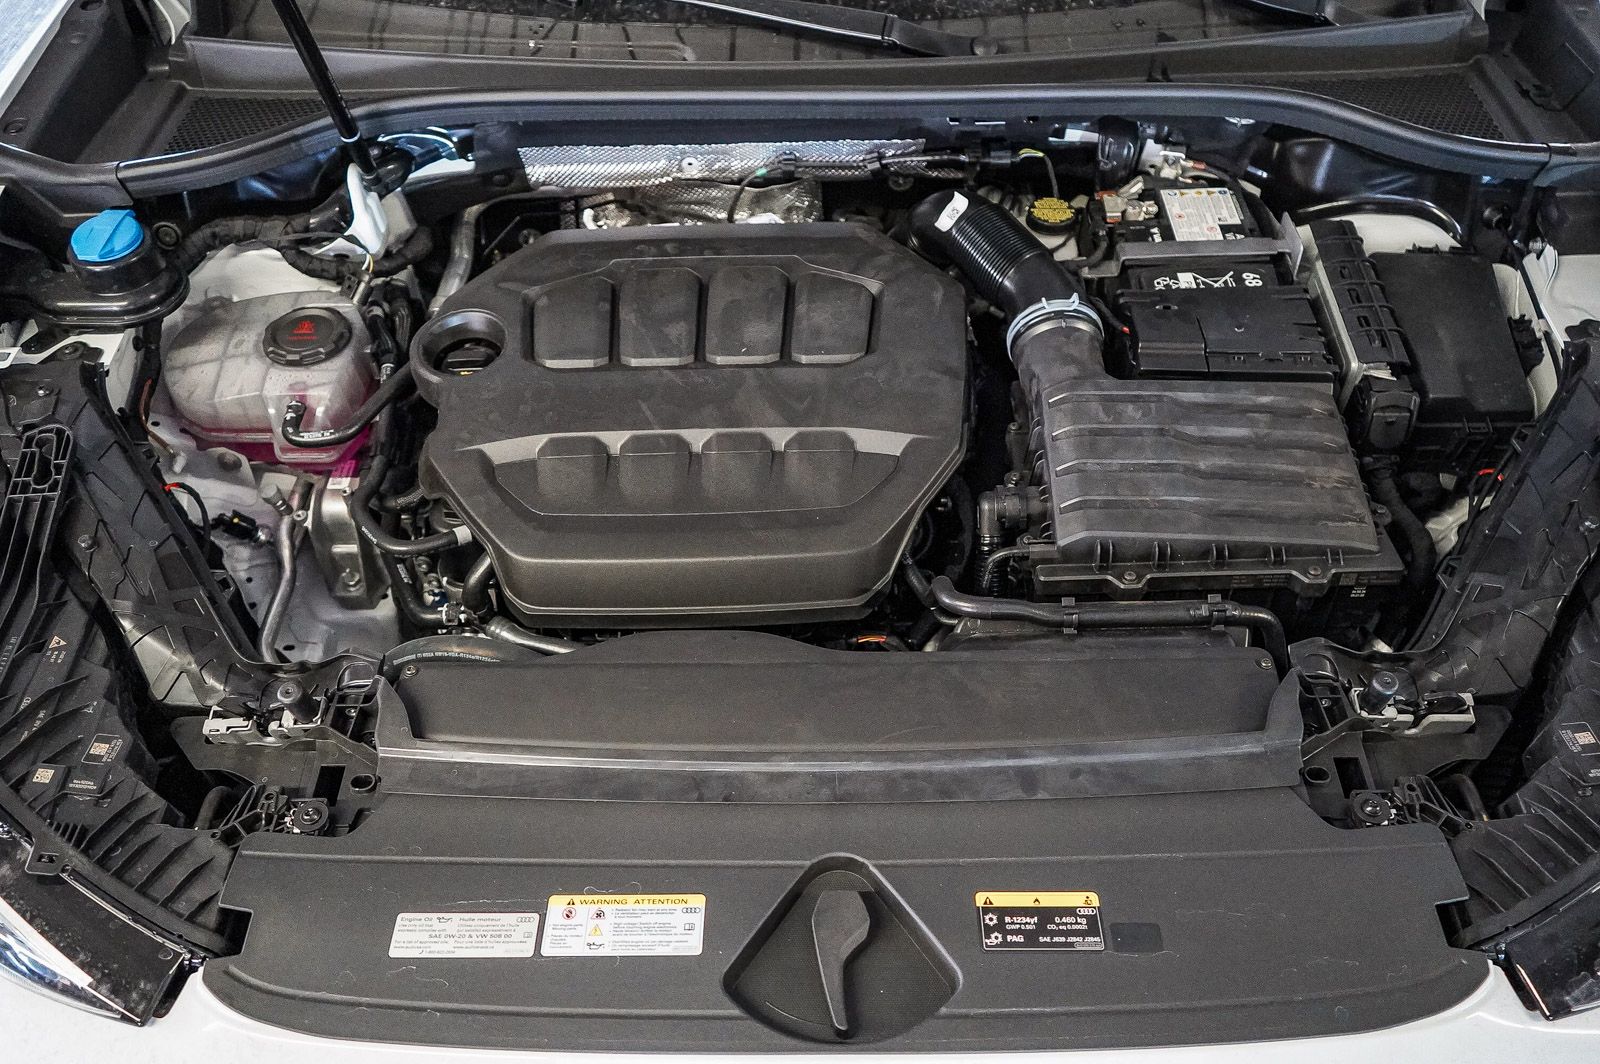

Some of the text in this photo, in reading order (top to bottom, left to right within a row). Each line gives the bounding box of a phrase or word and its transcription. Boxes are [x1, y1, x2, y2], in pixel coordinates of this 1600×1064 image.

[1004, 916, 1038, 924] R-1234yf
[1077, 916, 1087, 925] kg
[1006, 934, 1025, 942] PAG
